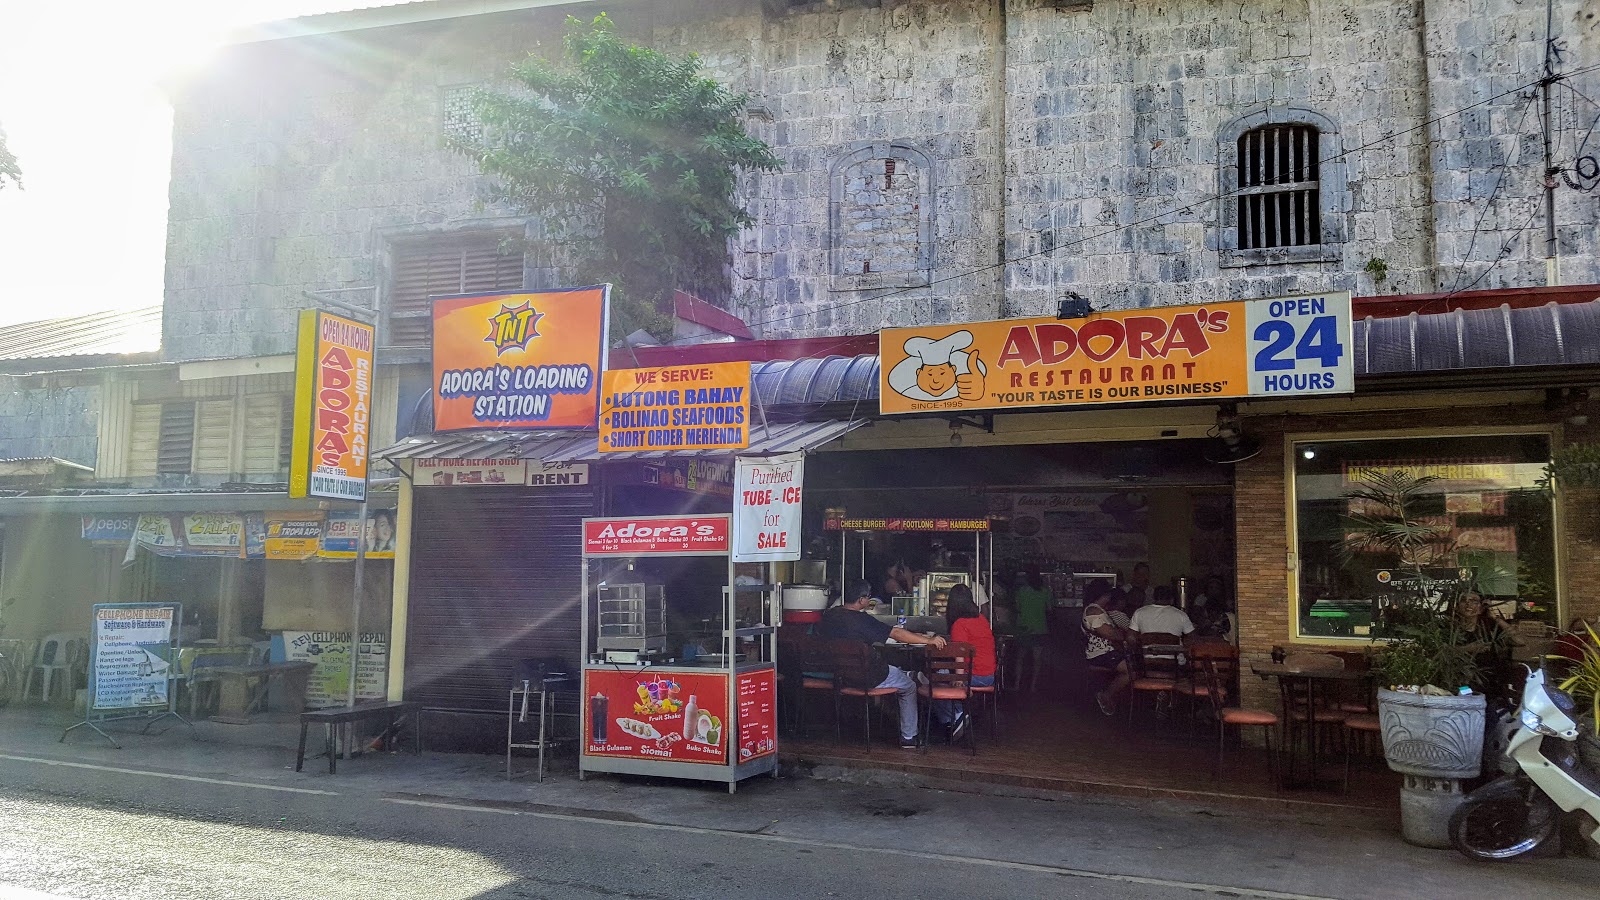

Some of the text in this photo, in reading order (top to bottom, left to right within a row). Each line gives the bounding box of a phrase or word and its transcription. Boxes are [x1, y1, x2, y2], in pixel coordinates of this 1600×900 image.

[1269, 297, 1325, 317] OPEN
[322, 317, 371, 352] OPEN 24 HOURS
[495, 307, 535, 347] TNT
[1253, 315, 1343, 372] 24
[440, 366, 589, 394] ADORA'S LOADING
[635, 368, 713, 384] WE SERVE:
[1010, 361, 1197, 388] RESTAURANT
[1264, 372, 1335, 391] HOURS
[613, 387, 744, 408] LUTONG BAHAY
[991, 380, 1228, 404] "YOUR TASTE IS OUR BUSINESS"
[352, 357, 369, 467] RESTAURANT
[474, 394, 548, 417] STATION
[612, 406, 744, 429] BOLINAO SEAFOODS
[610, 427, 743, 448] SHORT ORDER MERIENDA
[316, 466, 347, 477] SINCE 1995
[532, 473, 583, 485] RENT
[751, 465, 794, 485] Purified
[743, 489, 772, 506] TUBE
[782, 486, 801, 504] ICE
[97, 517, 133, 532] pepsi
[763, 509, 780, 527] for
[840, 520, 988, 529] CHEESE BURGER FOOTLONG HAMBURGER
[281, 527, 304, 536] TROPA
[597, 521, 715, 539] Adora's
[757, 532, 787, 549] SALE
[104, 620, 131, 631] Software
[137, 620, 166, 629] Hardware
[312, 632, 354, 643] CELLPHON
[640, 745, 673, 757] Siomai
[686, 743, 722, 756] Buko Shake
